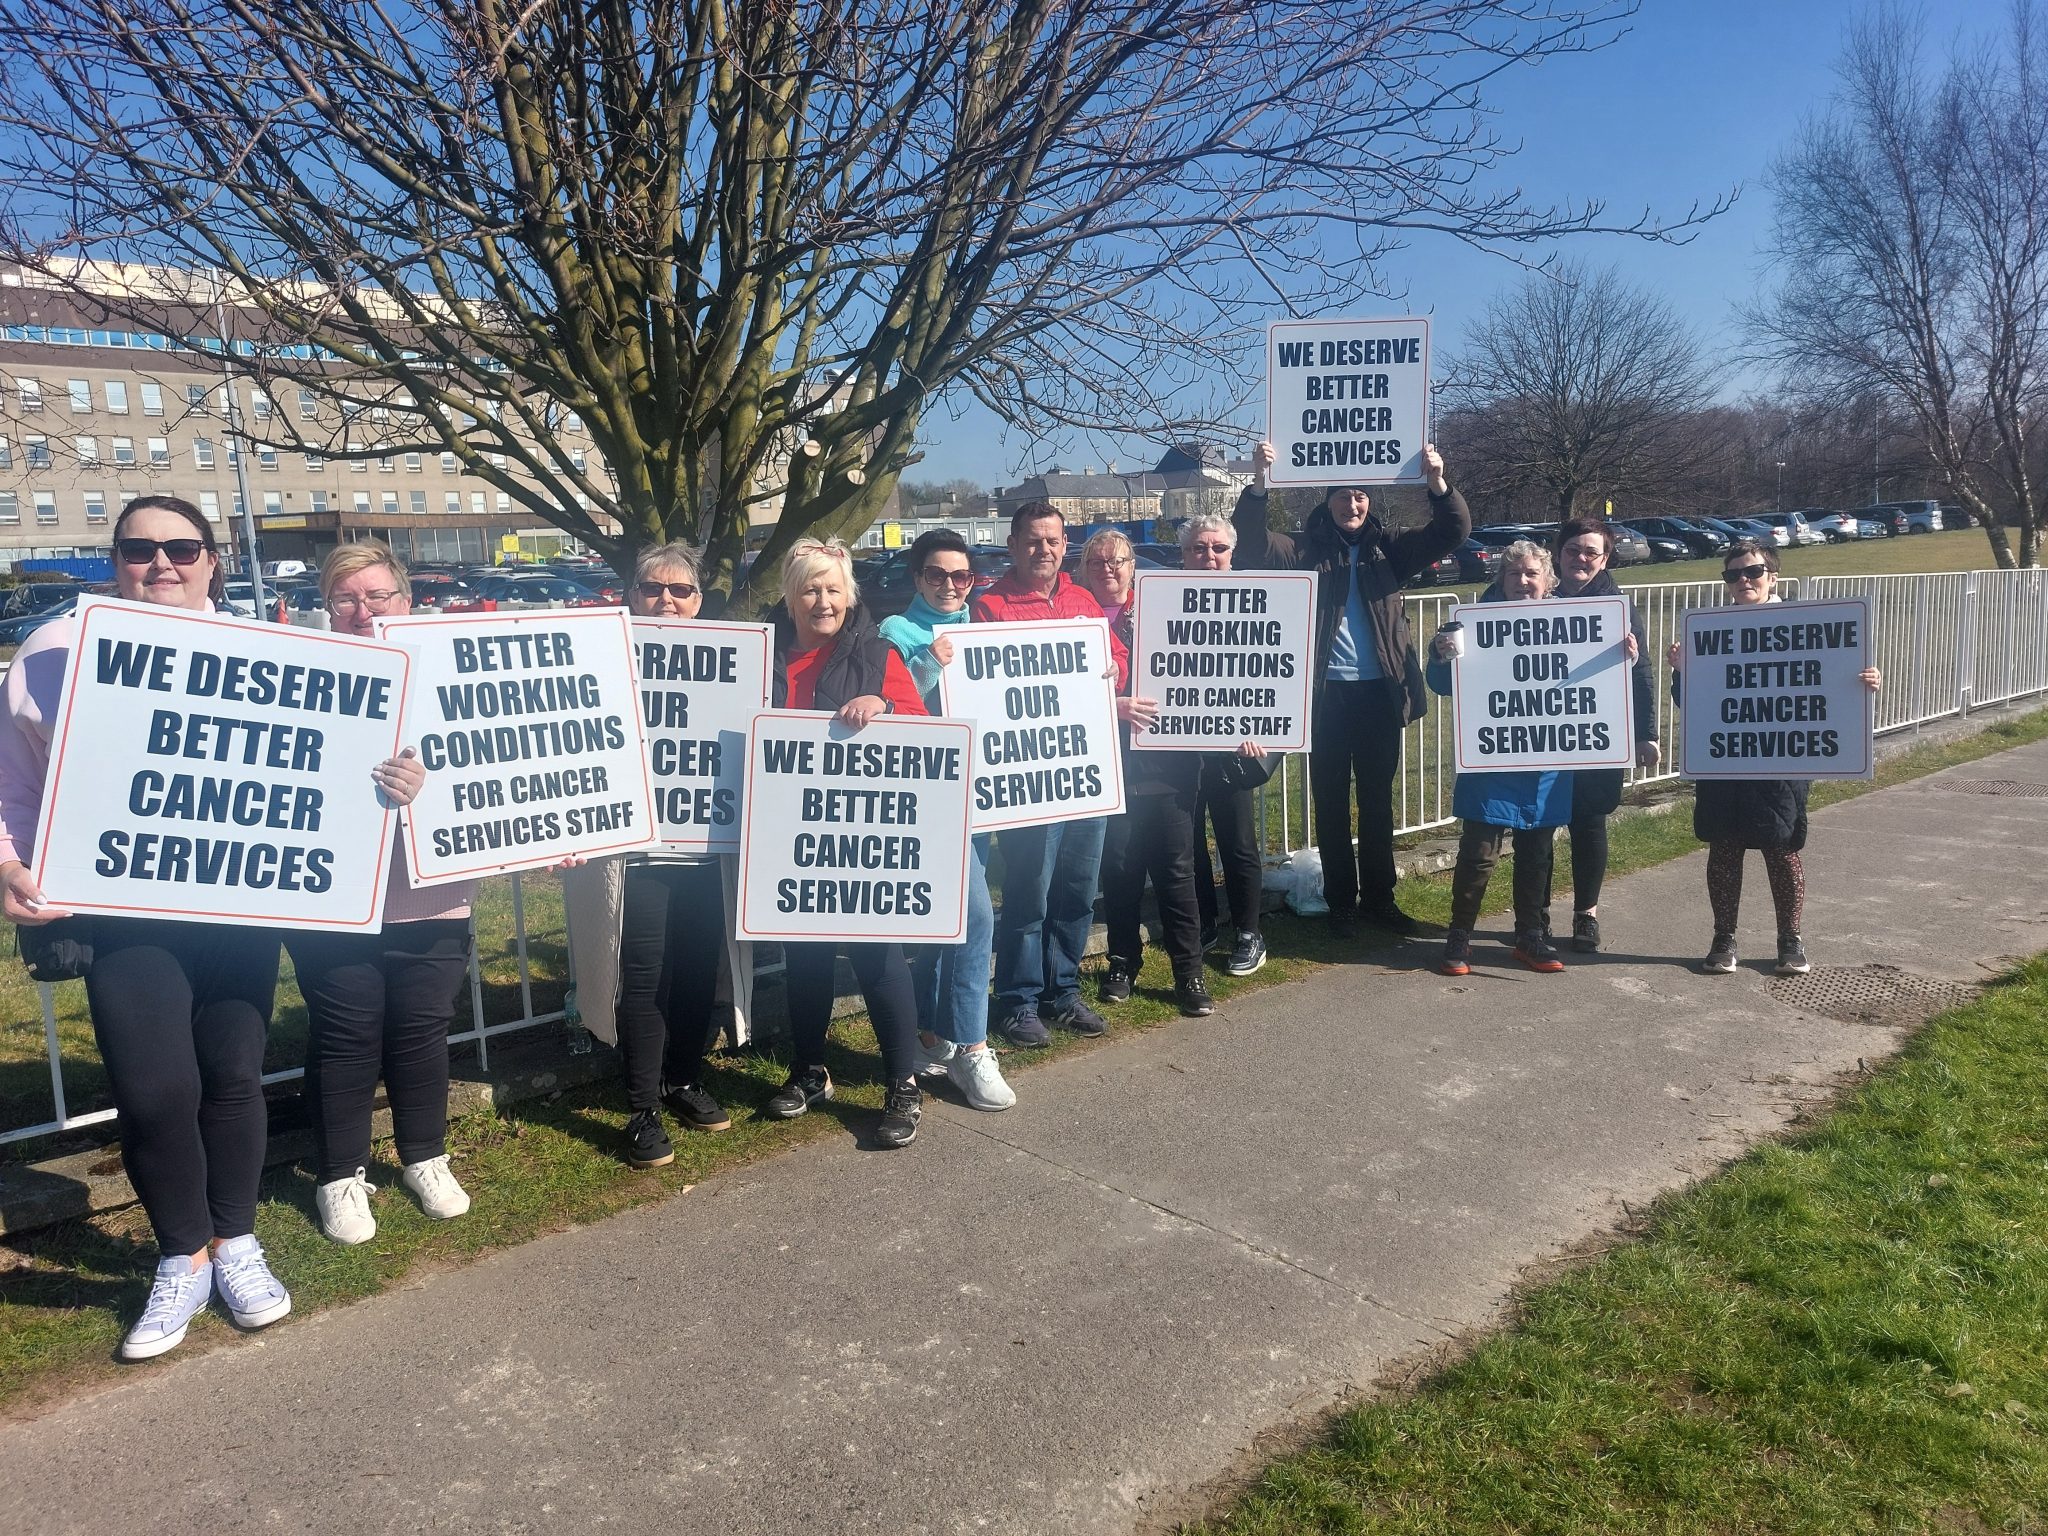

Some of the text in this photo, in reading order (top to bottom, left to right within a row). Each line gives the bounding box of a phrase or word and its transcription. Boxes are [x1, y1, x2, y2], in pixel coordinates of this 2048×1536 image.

[1278, 338, 1419, 367] WE DESERVE
[1307, 374, 1388, 400] BETTER
[1302, 407, 1392, 434] CANCER
[1292, 440, 1400, 467] SERVICES
[1183, 589, 1267, 613] BETTER
[1167, 620, 1281, 646] WORKING
[1477, 615, 1602, 648] UPGRADE
[1694, 621, 1857, 656] WE DESERVE
[453, 633, 573, 673] BETTER
[635, 643, 736, 683] RADE
[965, 642, 1089, 680] UPGRADE
[1151, 652, 1294, 678] CONDITIONS
[1513, 653, 1569, 682] OUR
[97, 638, 391, 720] WE DESERVE
[1726, 660, 1821, 689] BETTER
[437, 674, 600, 721] WORKING
[642, 691, 688, 728] UR
[1006, 686, 1059, 720] OUR
[1166, 688, 1275, 707] FOR CANCER
[1489, 687, 1596, 718] CANCER
[1721, 695, 1826, 723] CANCER
[147, 710, 323, 772] BETTER
[421, 716, 624, 770] CONDITIONS
[1149, 716, 1291, 735] SERVICES STAFF
[1478, 722, 1609, 754] SERVICES
[653, 739, 721, 777] CER
[764, 740, 959, 780] WE DESERVE
[983, 725, 1087, 765] CANCER
[1710, 730, 1838, 758] SERVICES
[129, 770, 323, 831] CANCER
[453, 767, 608, 811] FOR CANCER
[975, 765, 1101, 810] SERVICES
[655, 787, 735, 826] ICES
[802, 788, 917, 824] BETTER
[433, 802, 632, 857] SERVICES STAFF
[96, 830, 333, 893] SERVICES
[794, 833, 920, 869] CANCER
[777, 879, 931, 915] SERVICES
